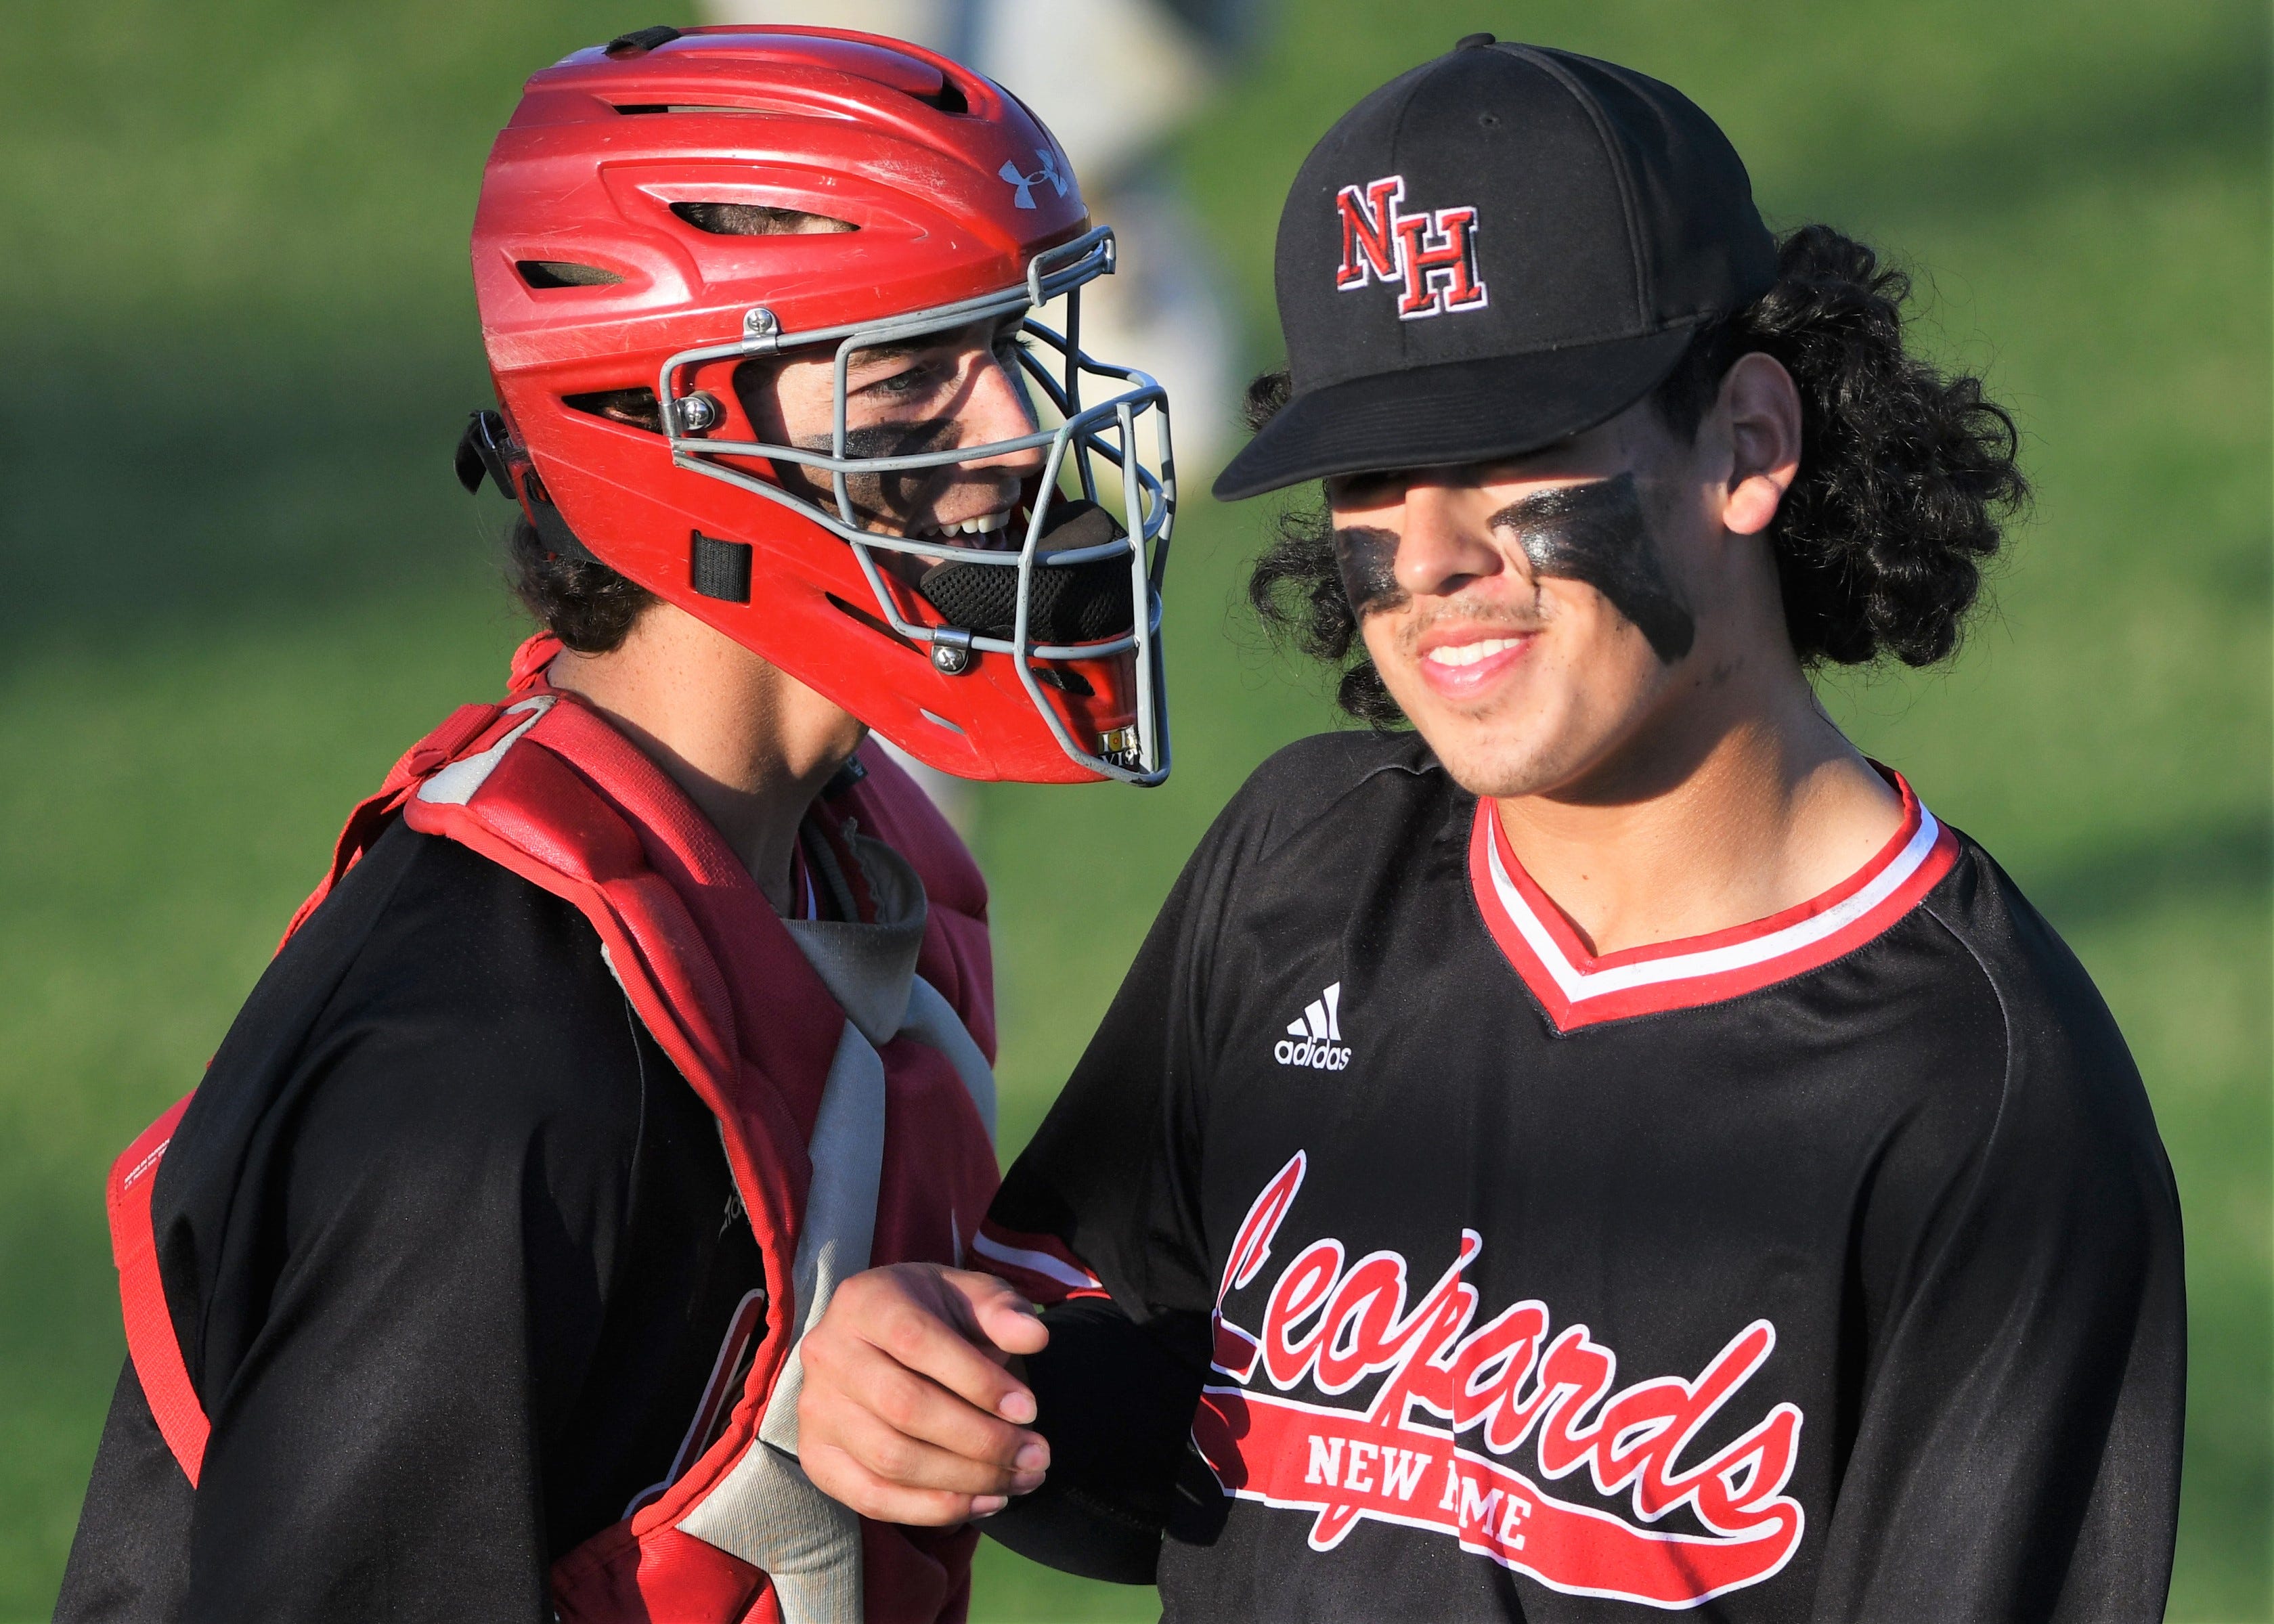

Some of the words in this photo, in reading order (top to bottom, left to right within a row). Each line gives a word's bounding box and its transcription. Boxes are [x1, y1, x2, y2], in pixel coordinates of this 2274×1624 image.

[1336, 175, 1488, 320] NH
[1274, 1036, 1352, 1070] adidas
[1210, 1149, 1804, 1552] Leopards
[1305, 1435, 1433, 1501] NEW
[1439, 1459, 1532, 1551] HME
